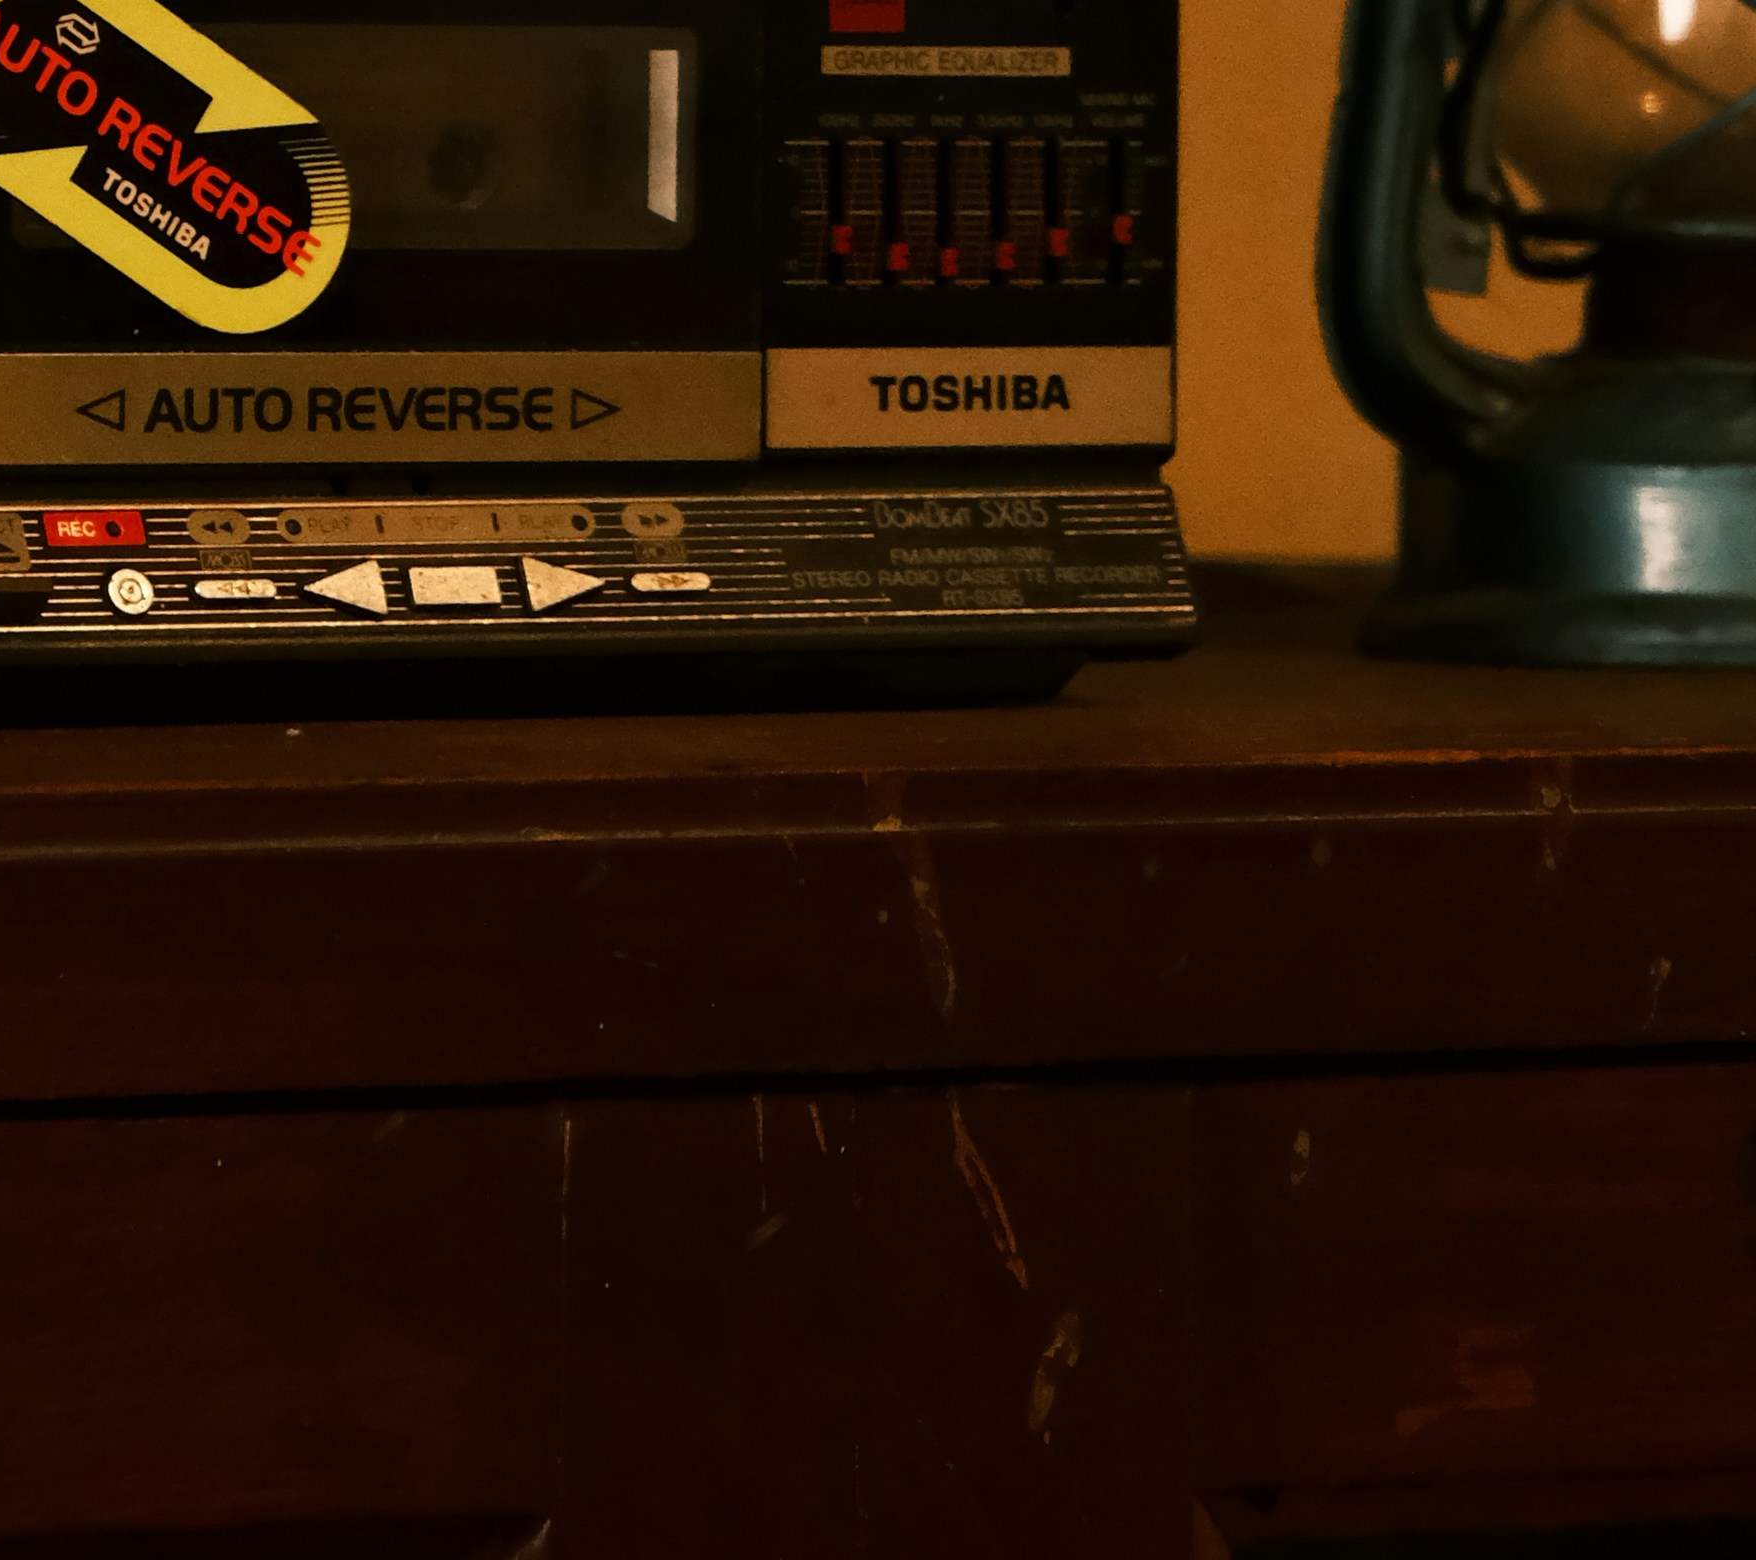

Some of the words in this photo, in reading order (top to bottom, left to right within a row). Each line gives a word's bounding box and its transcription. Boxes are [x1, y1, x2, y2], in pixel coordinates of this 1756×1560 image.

[834, 50, 931, 71] GRAPHIC
[938, 50, 1059, 72] EQUALIZER
[97, 96, 322, 278] REVERSE
[103, 166, 212, 262] TOSHIBA
[144, 388, 292, 433] AUTO
[307, 387, 553, 432] REVERSE
[868, 374, 1070, 412] TOSHIBA
[57, 520, 96, 538] REC
[979, 499, 1050, 529] SX85
[791, 569, 871, 589] STEREO
[878, 570, 939, 586] RADIO
[945, 567, 1046, 586] CASSETTE
[1053, 565, 1162, 584] RECORDER
